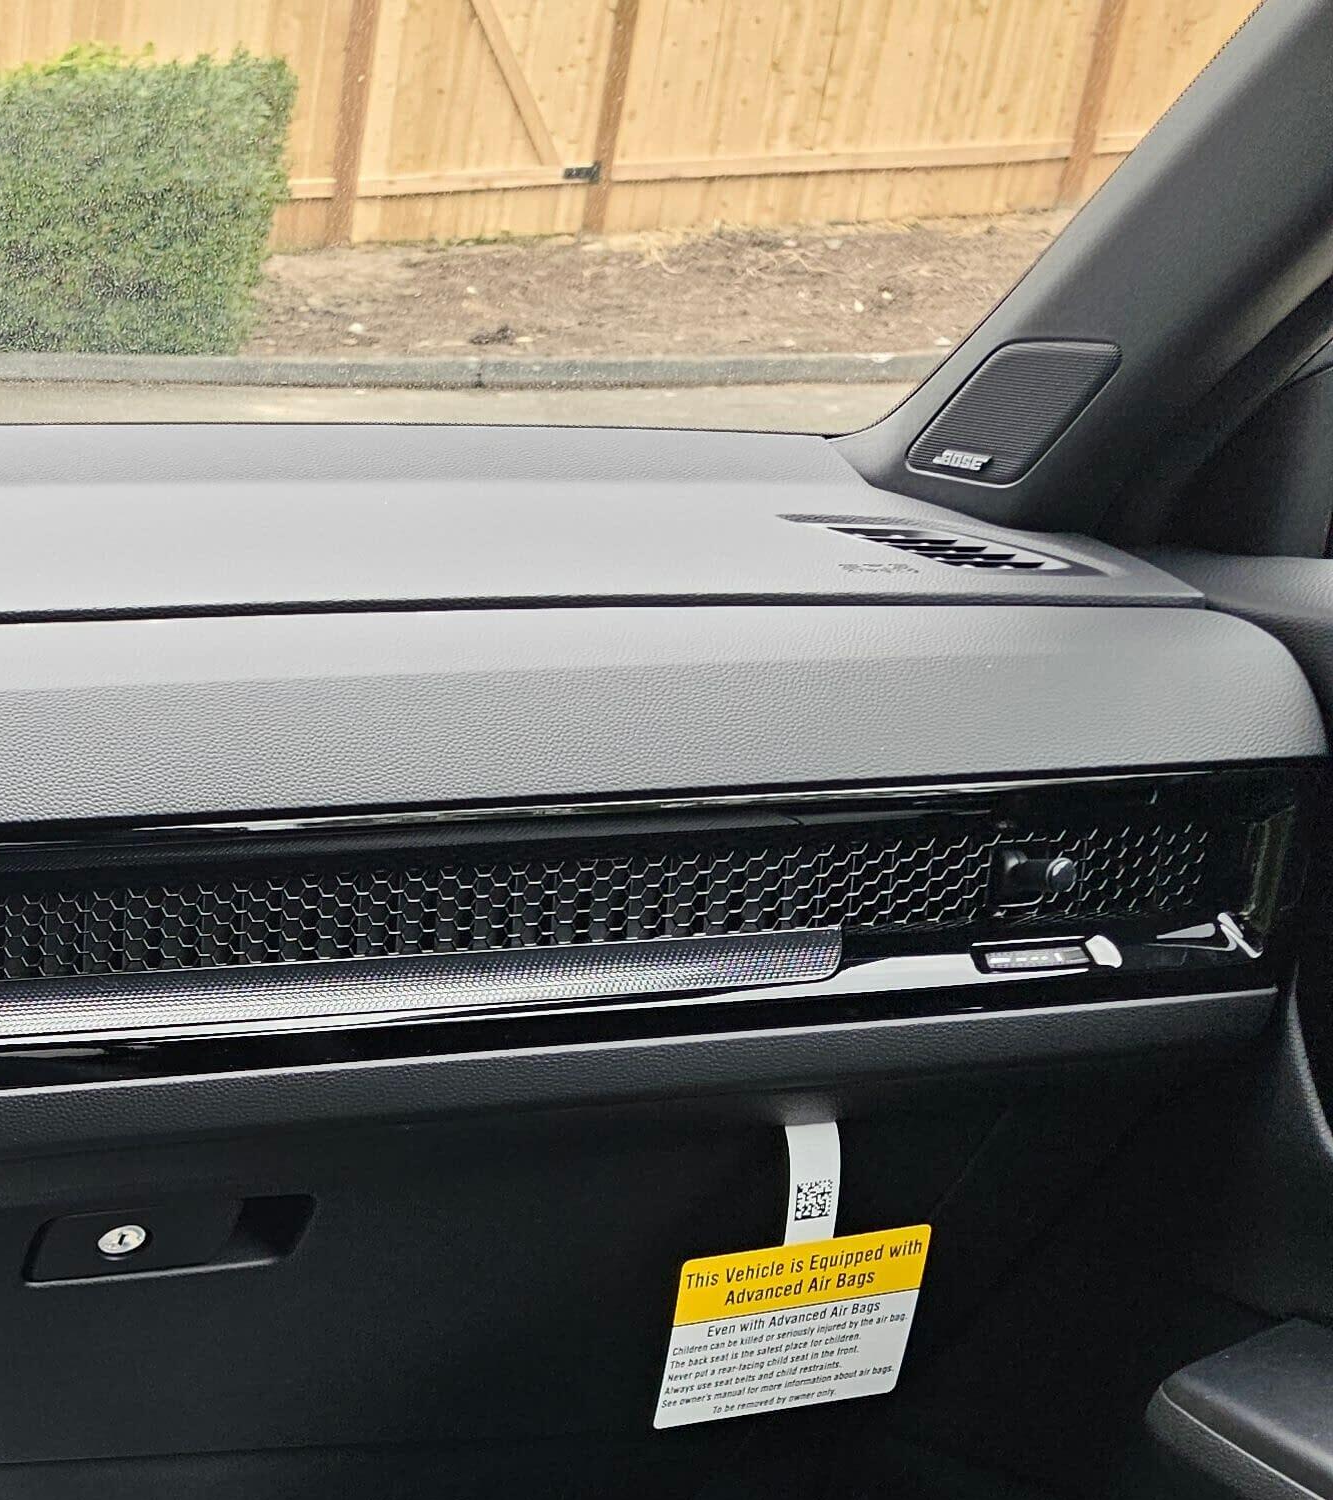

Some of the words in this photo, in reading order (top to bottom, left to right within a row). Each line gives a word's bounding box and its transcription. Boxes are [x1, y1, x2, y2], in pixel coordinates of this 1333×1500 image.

[686, 1271, 719, 1289] This
[726, 1261, 784, 1283] Vehicle
[790, 1258, 804, 1273] is
[809, 1244, 884, 1272] Equipped
[890, 1239, 922, 1258] with
[724, 1279, 803, 1306] Advanced
[807, 1276, 832, 1293] Air
[836, 1272, 875, 1289] Bags
[707, 1325, 736, 1337] Even
[740, 1318, 765, 1332] with
[768, 1308, 827, 1328] Advanced
[830, 1305, 848, 1318] Air
[851, 1302, 880, 1315] Bags
